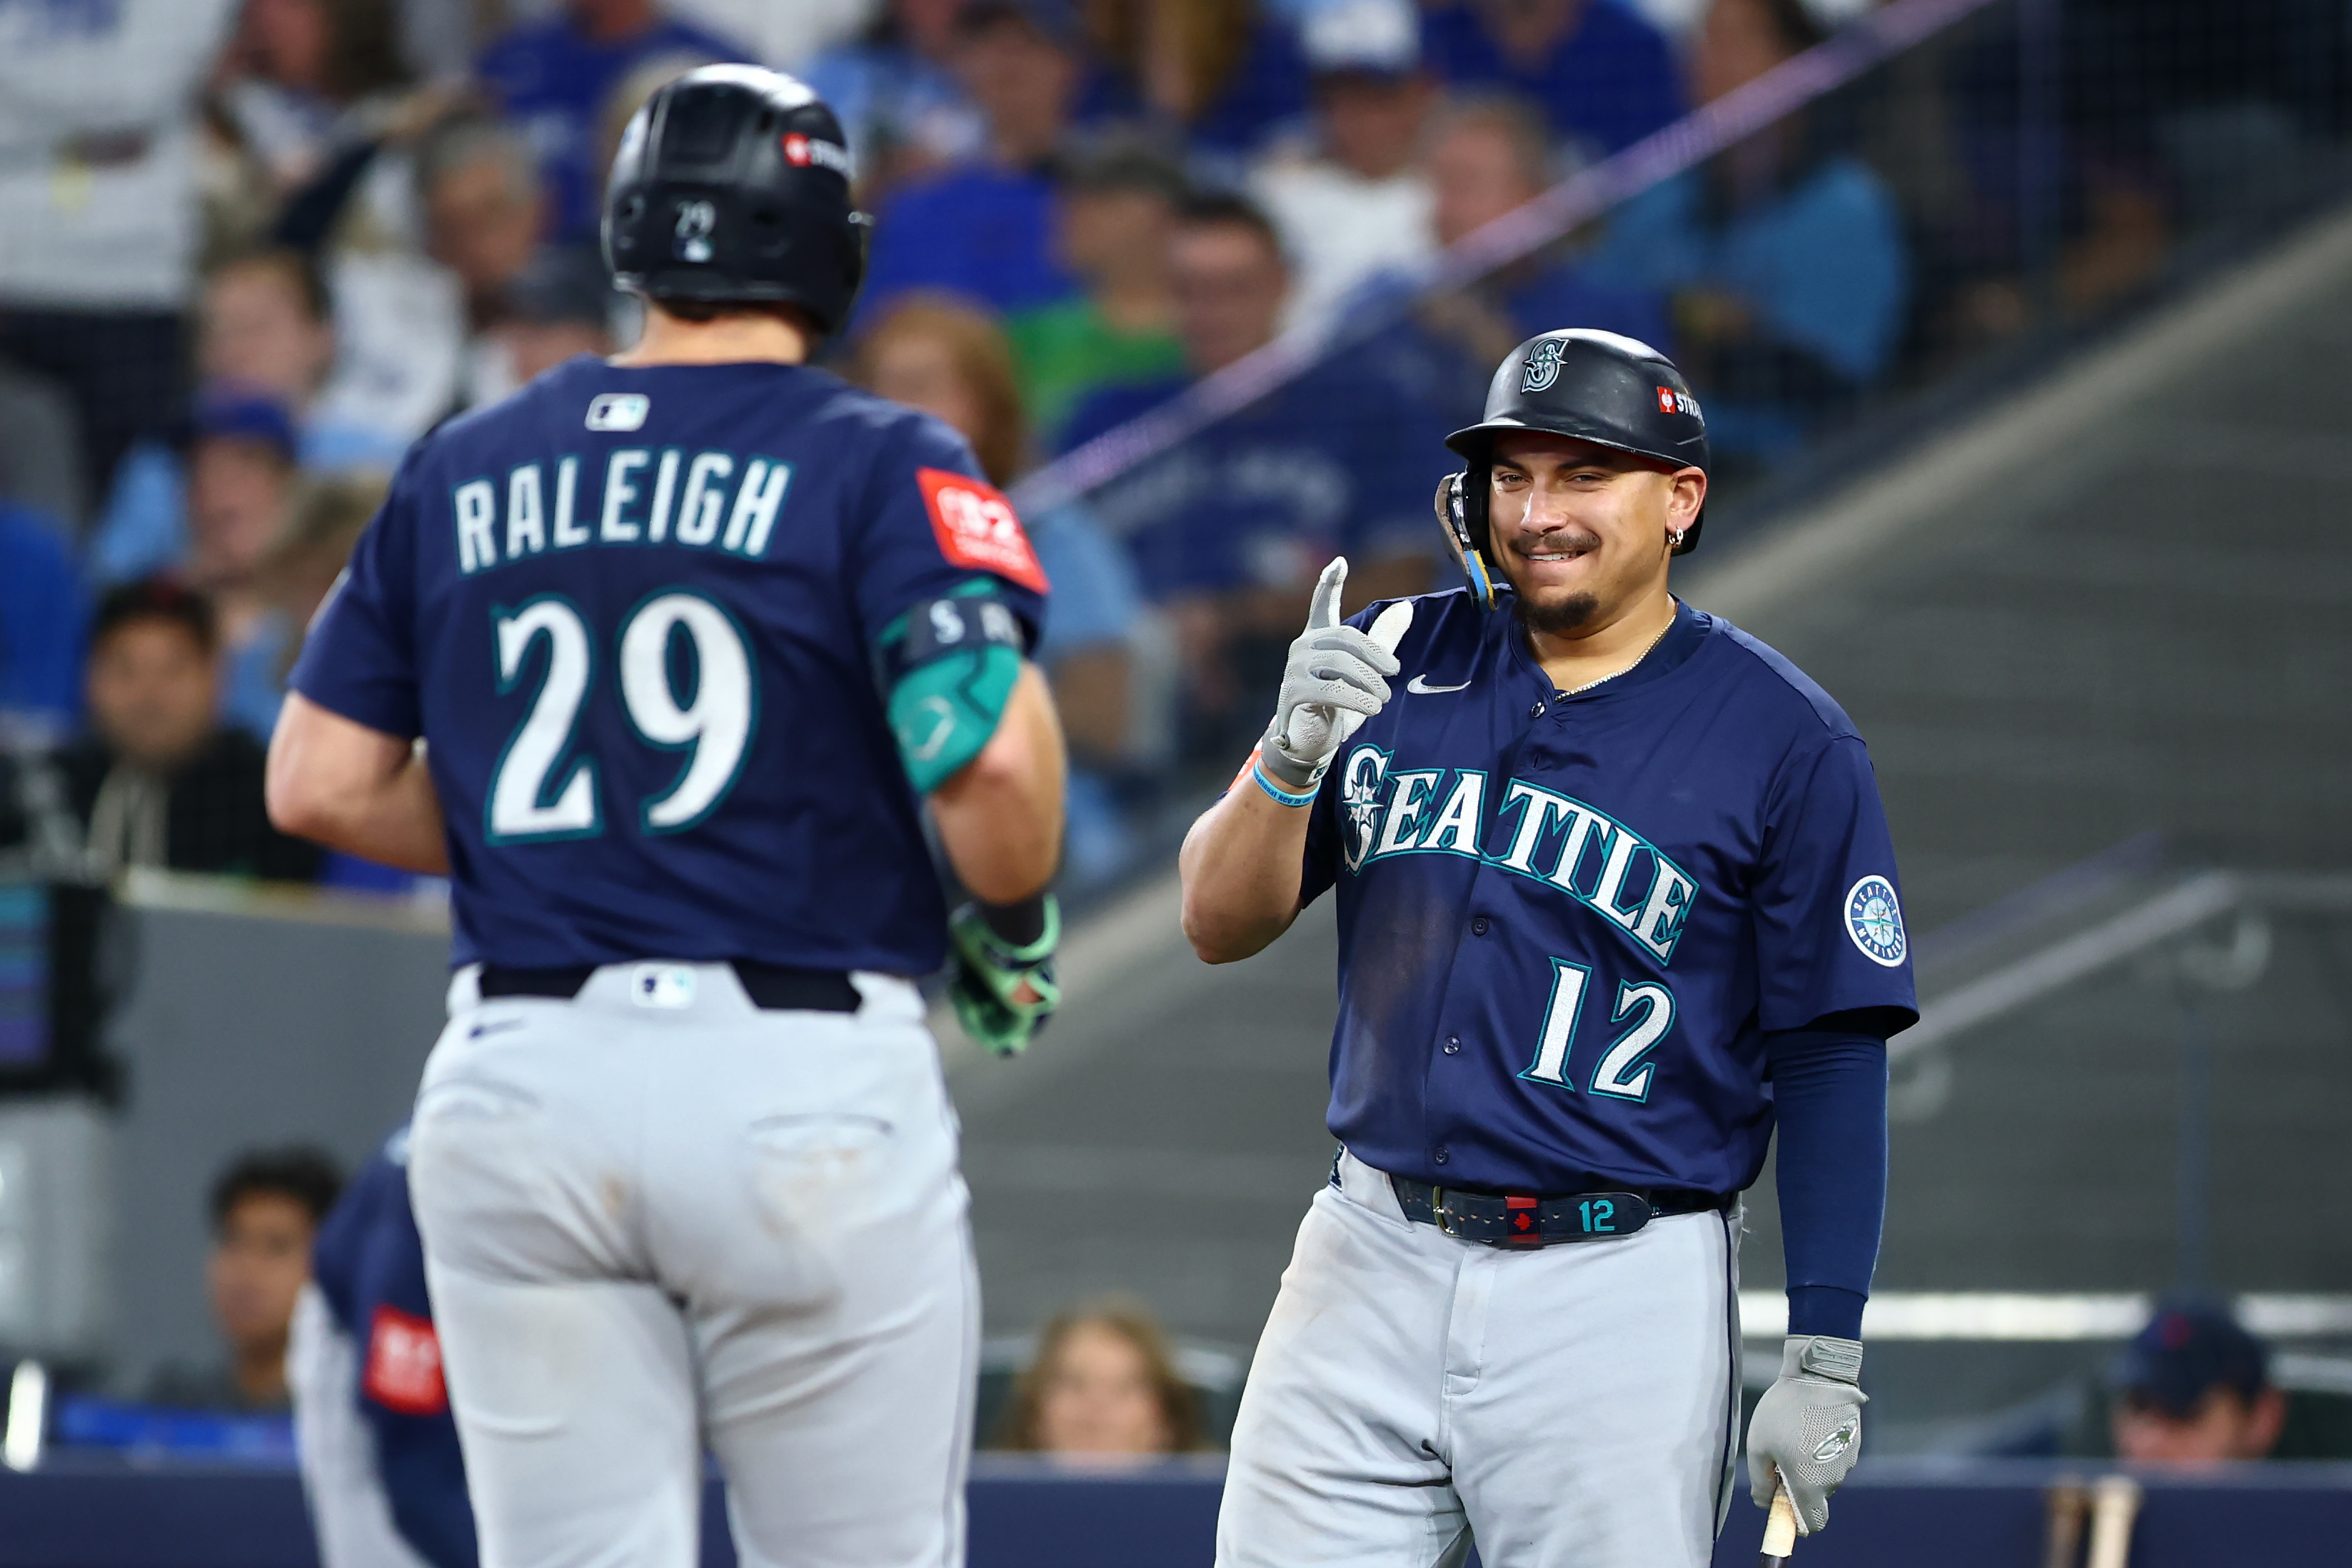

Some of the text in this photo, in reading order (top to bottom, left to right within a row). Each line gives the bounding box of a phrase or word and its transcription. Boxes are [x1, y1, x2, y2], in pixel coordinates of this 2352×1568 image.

[1521, 337, 1569, 393] S
[1675, 392, 1705, 427] STRA
[453, 446, 794, 574] RALEIGH
[486, 586, 758, 845] 29
[1342, 743, 1699, 966] SEATTLE
[1854, 884, 1897, 917] SEATTLE
[1857, 928, 1902, 958] MARINERS
[1517, 957, 1677, 1102] 12
[1578, 1200, 1616, 1232] 12
